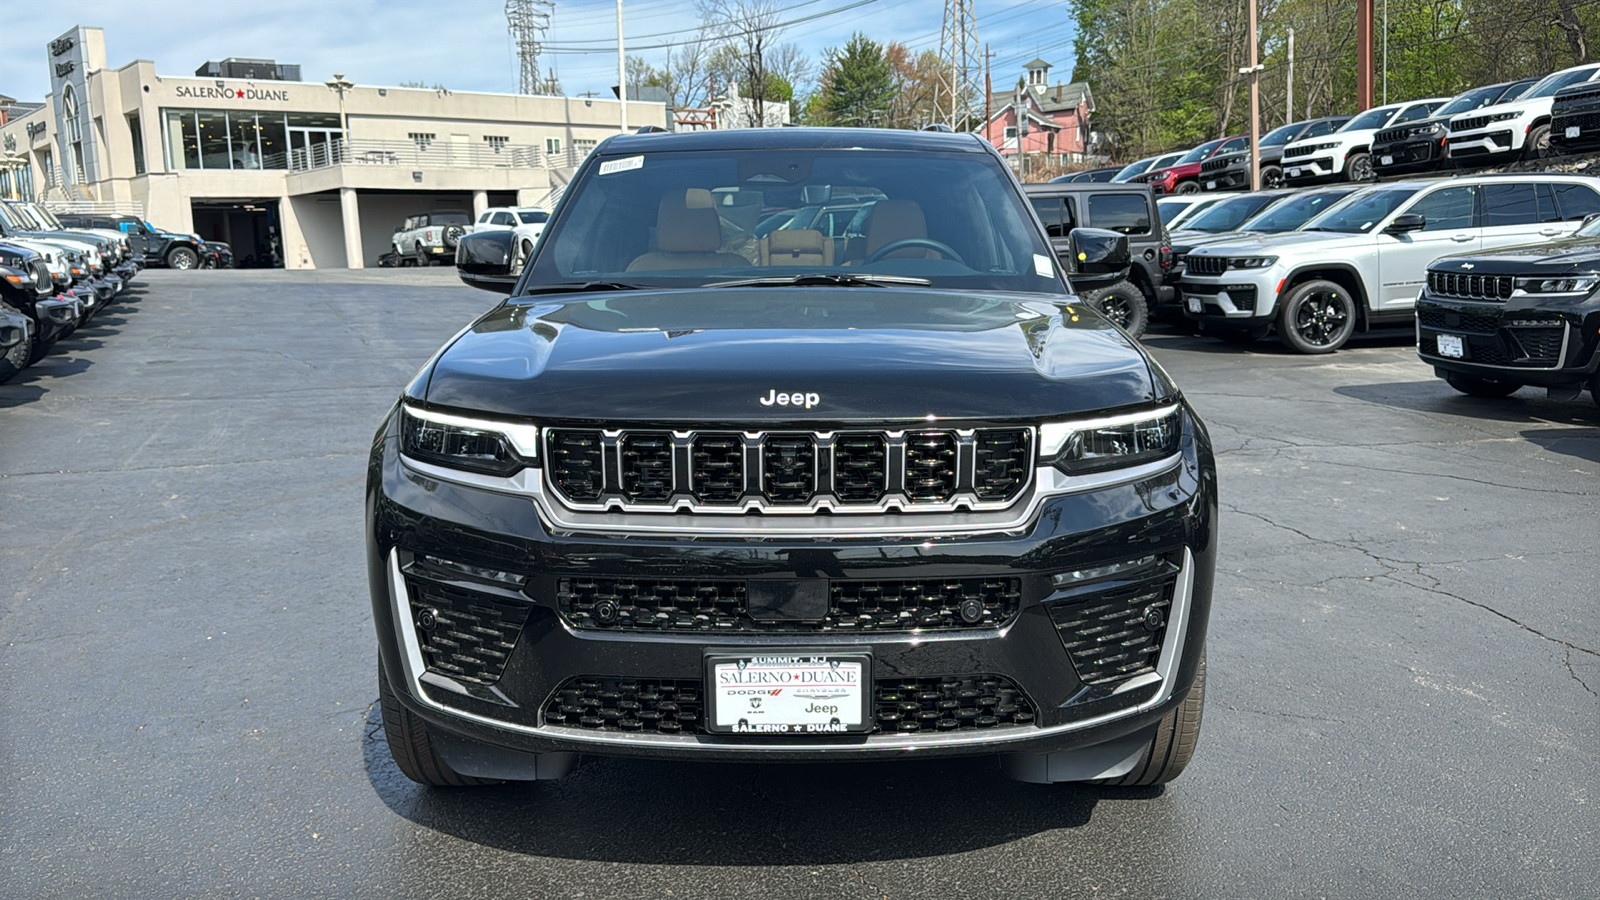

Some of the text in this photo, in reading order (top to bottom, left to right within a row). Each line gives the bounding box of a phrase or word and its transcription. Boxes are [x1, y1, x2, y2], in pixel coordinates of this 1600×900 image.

[176, 86, 289, 101] SALERNO DUANE
[759, 389, 820, 409] Jeep
[810, 656, 827, 664] NJ
[720, 671, 856, 684] SALERNO DUANE
[805, 703, 838, 715] Jeep
[732, 723, 848, 733] SALERNO DUANE
